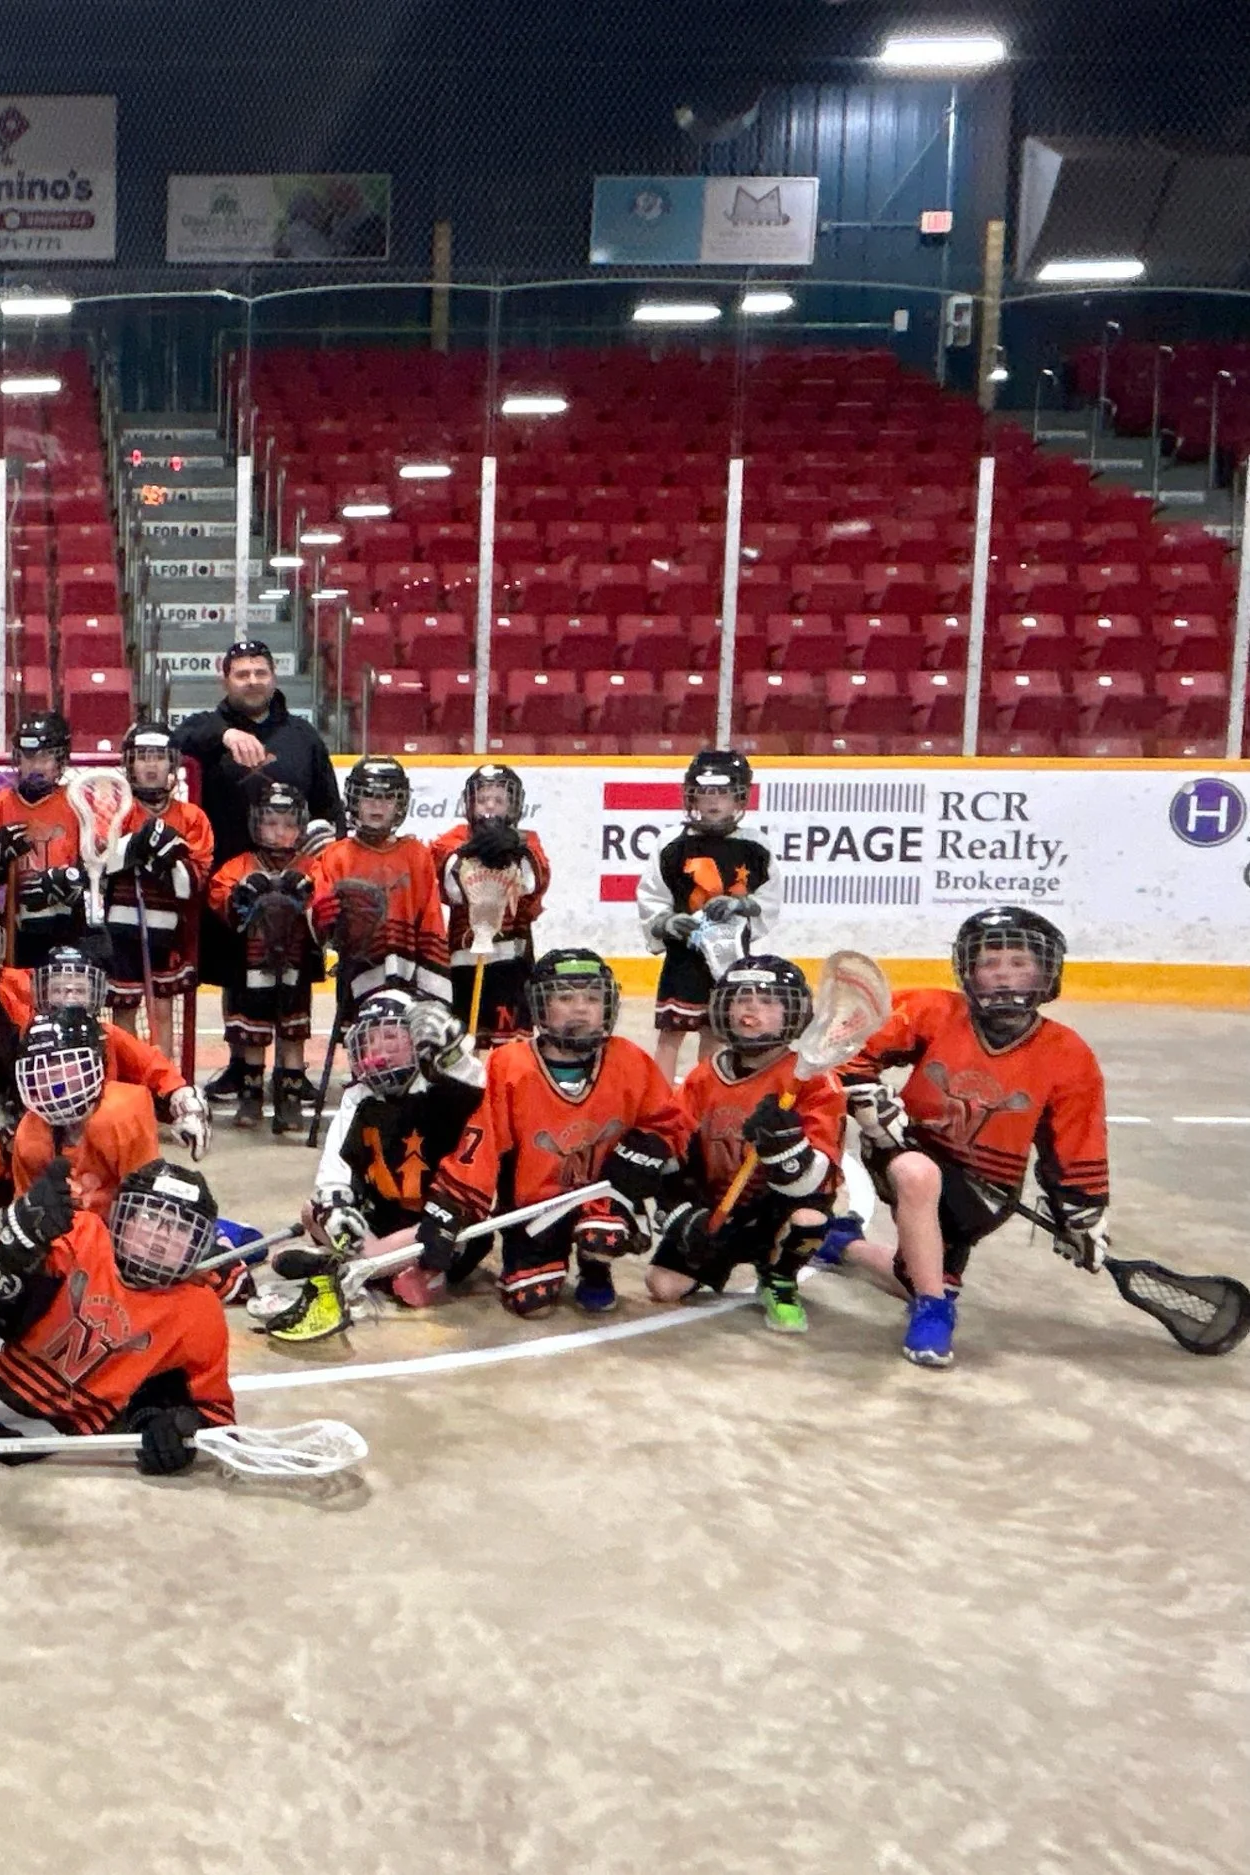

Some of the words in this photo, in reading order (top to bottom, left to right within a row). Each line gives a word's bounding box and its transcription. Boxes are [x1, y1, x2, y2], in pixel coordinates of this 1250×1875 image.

[938, 791, 1030, 822] RCR
[1187, 795, 1228, 833] H
[936, 829, 1069, 871] Realty,
[935, 870, 1061, 897] Brokerage
[458, 1126, 483, 1164] 7
